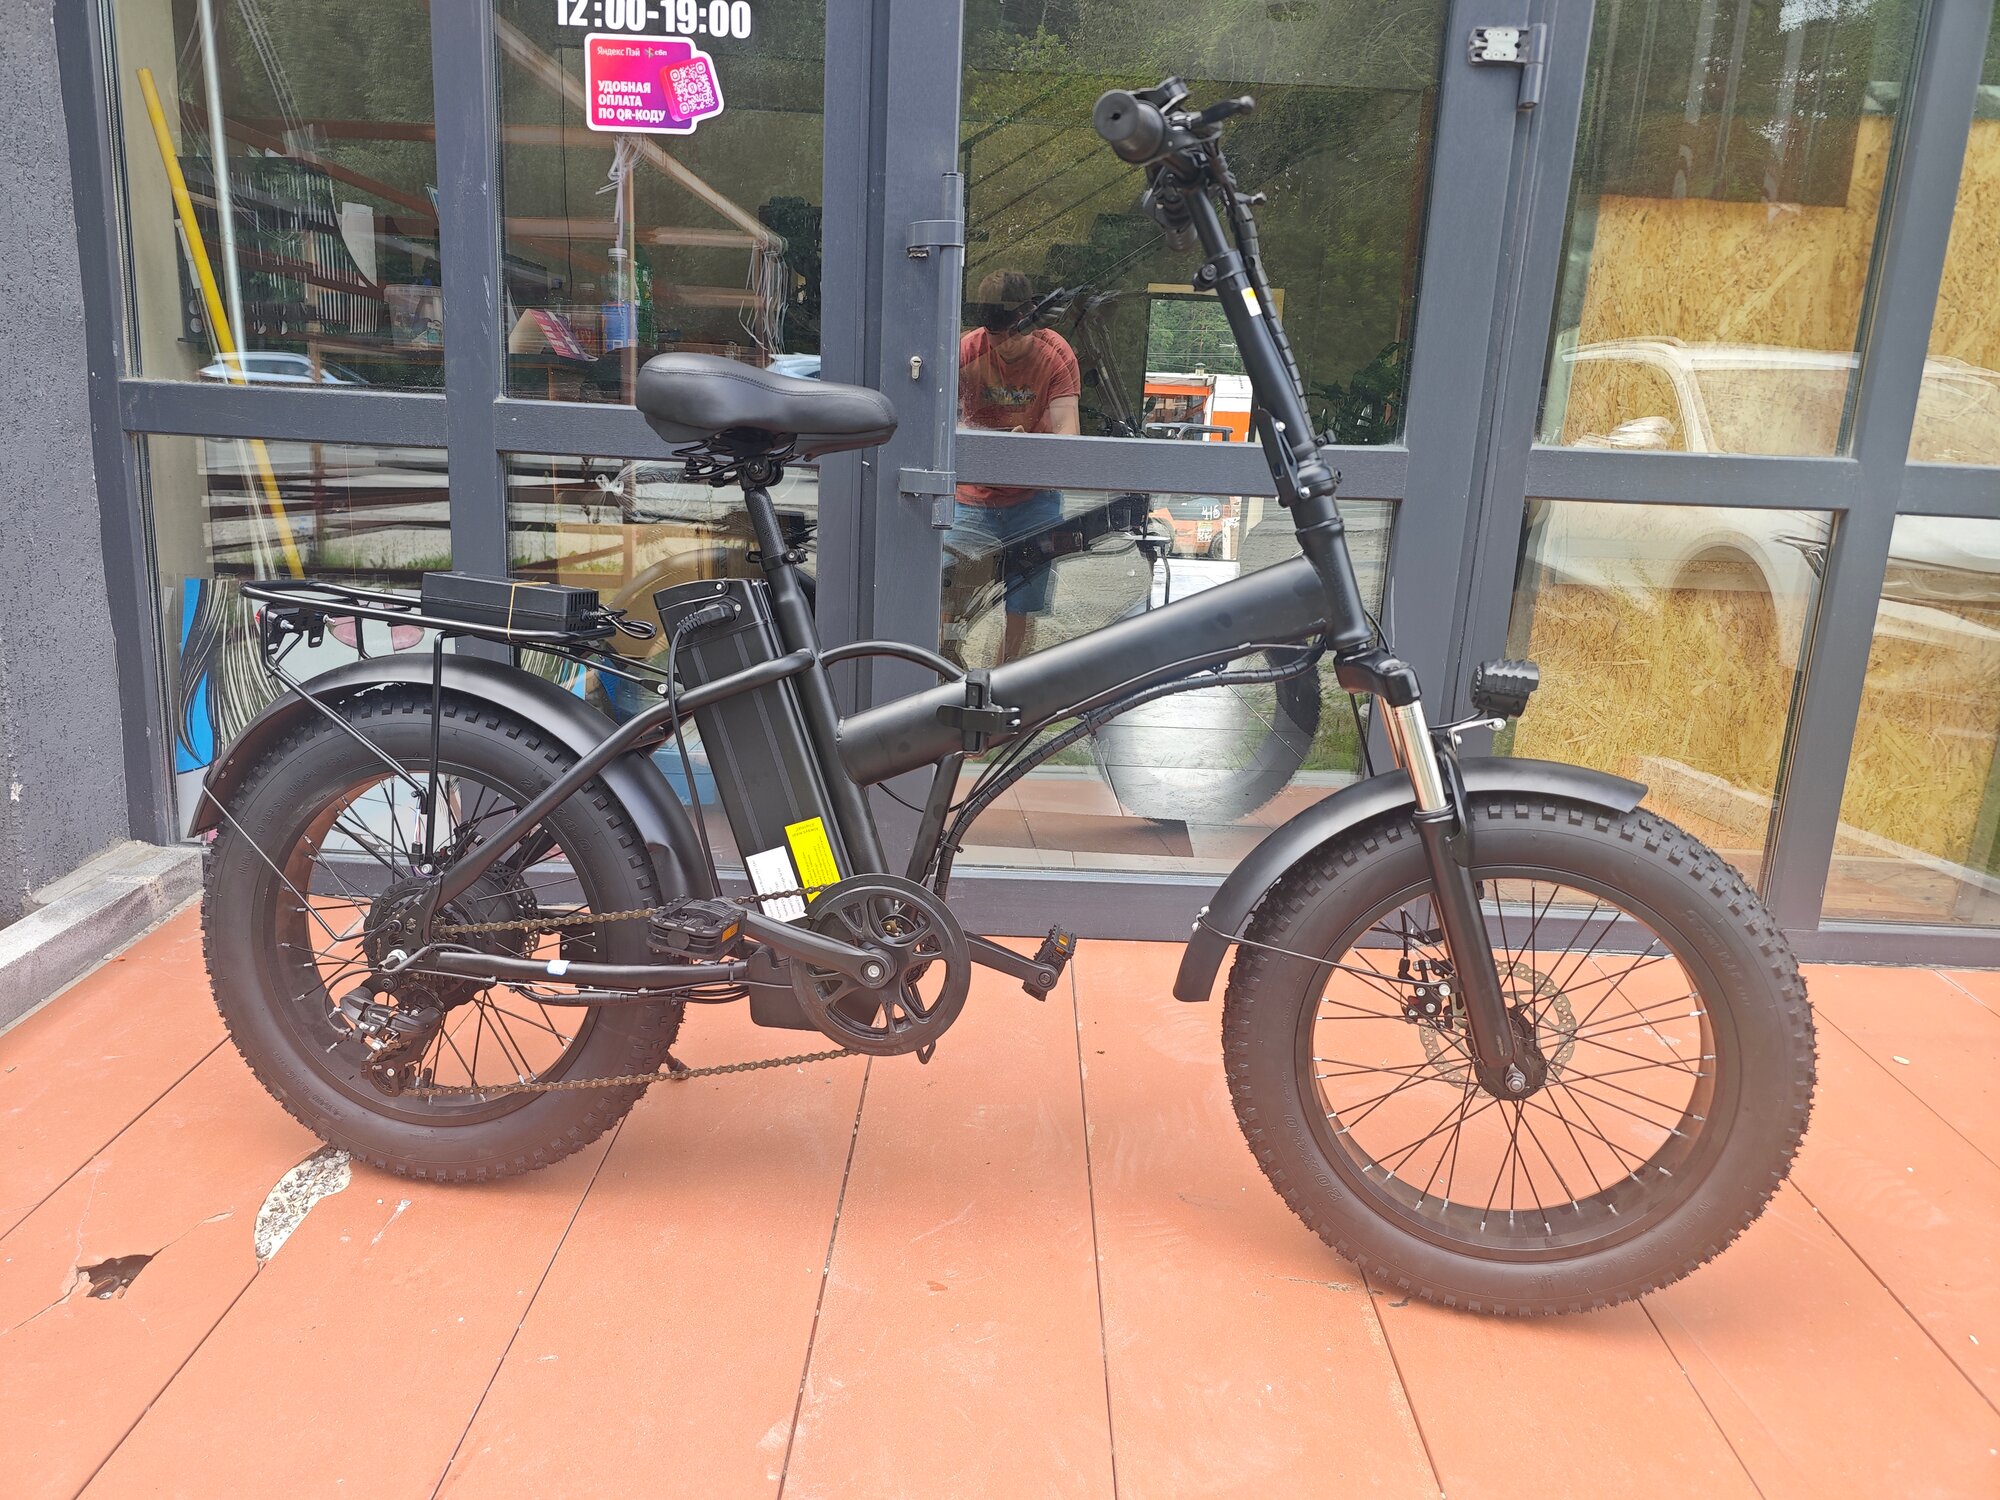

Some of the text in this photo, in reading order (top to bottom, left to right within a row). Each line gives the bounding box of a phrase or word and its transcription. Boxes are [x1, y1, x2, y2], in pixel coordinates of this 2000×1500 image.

[597, 46, 640, 56] Яндекс Пэй
[598, 80, 651, 94] УДОБНАЯ
[598, 94, 643, 107] ОПЛАТА
[598, 108, 666, 123] ПО QR-КОДУ
